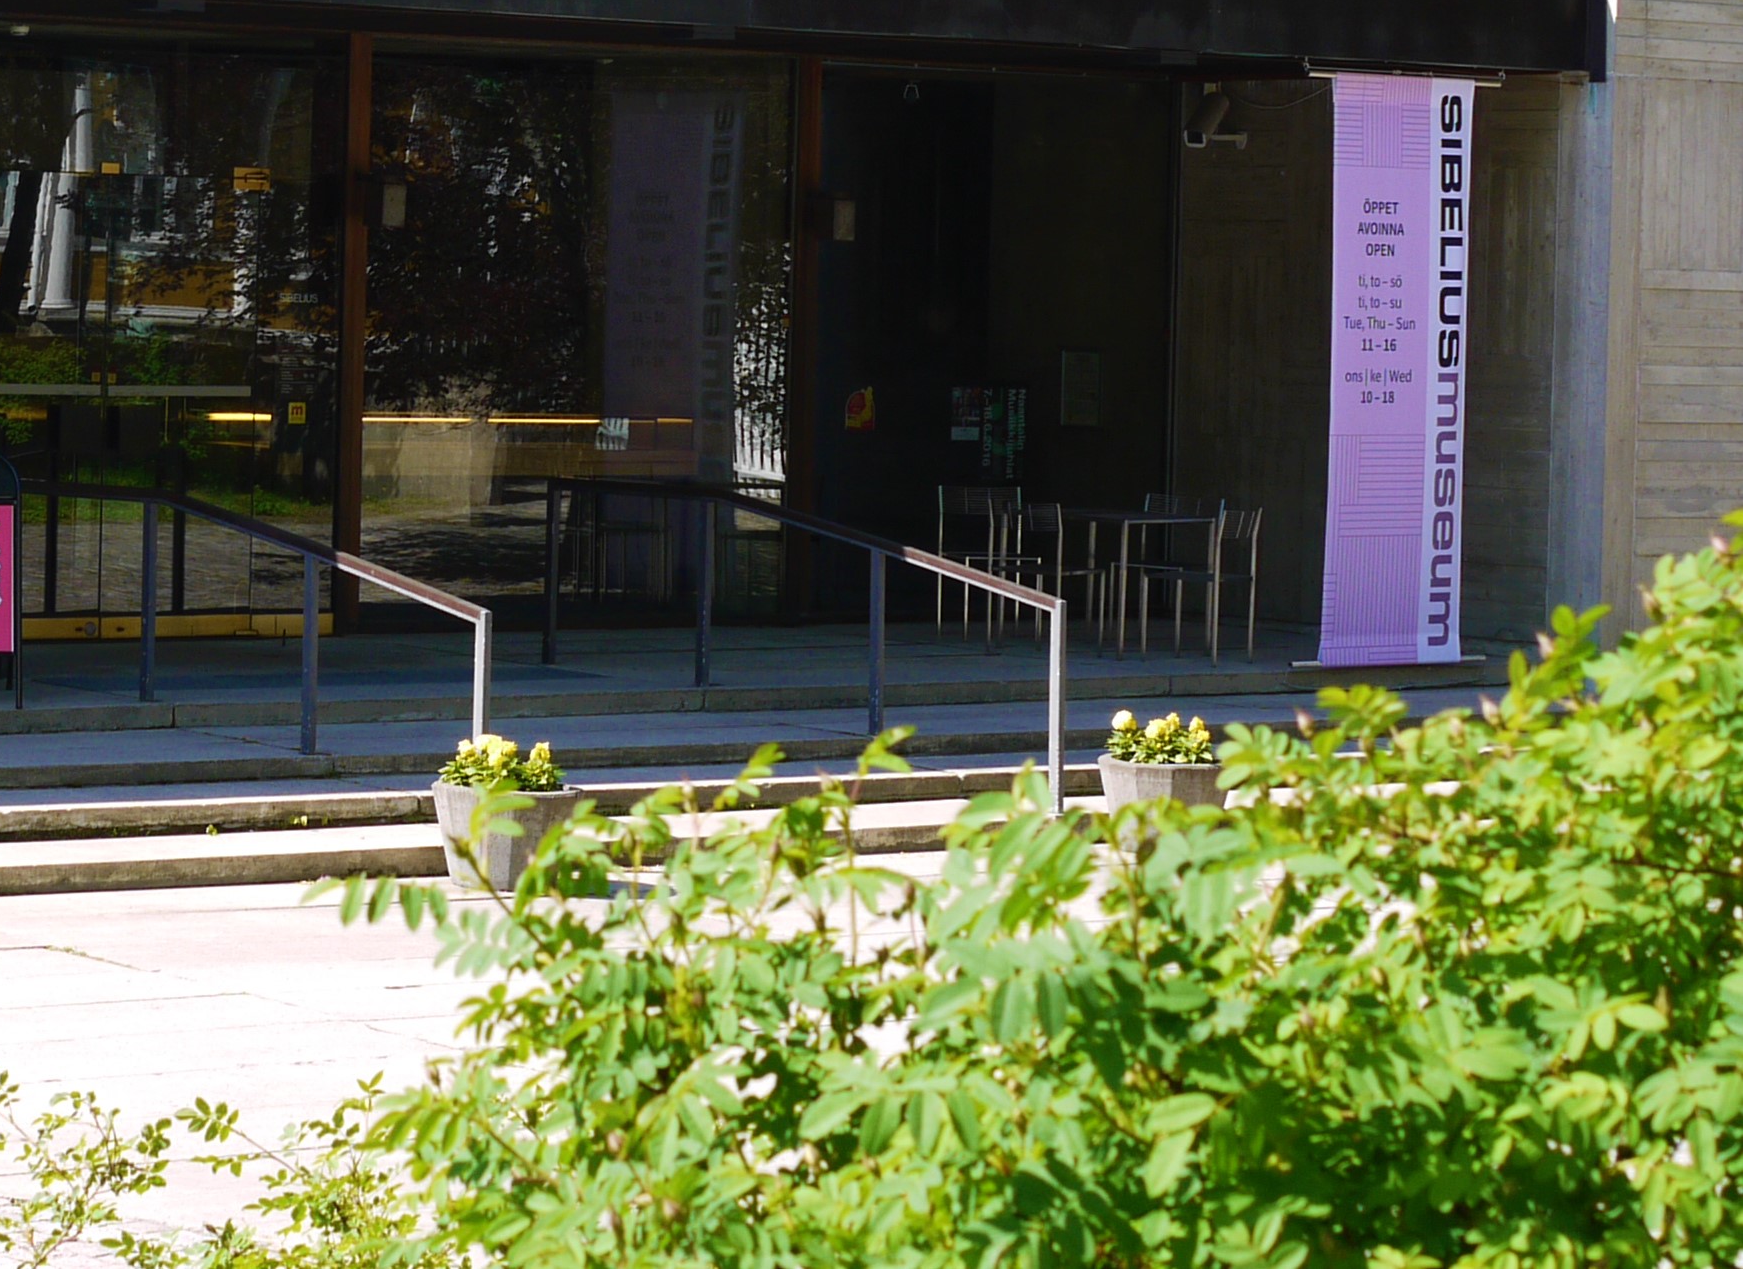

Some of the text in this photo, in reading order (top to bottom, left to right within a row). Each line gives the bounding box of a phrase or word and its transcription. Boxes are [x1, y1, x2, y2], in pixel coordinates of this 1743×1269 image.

[1363, 198, 1399, 215] ÖPPET
[1357, 221, 1405, 236] AVOINNA
[1365, 243, 1395, 257] OPEN
[1358, 274, 1368, 289] ti,
[1370, 275, 1381, 288] to
[1358, 295, 1368, 311] ti,
[1370, 296, 1381, 309] to
[1389, 298, 1403, 309] su
[1343, 315, 1365, 332] Tue,
[1367, 316, 1386, 330] Thu
[1395, 316, 1416, 331] Sun
[1426, 94, 1464, 647] SIBELIUSmuseum
